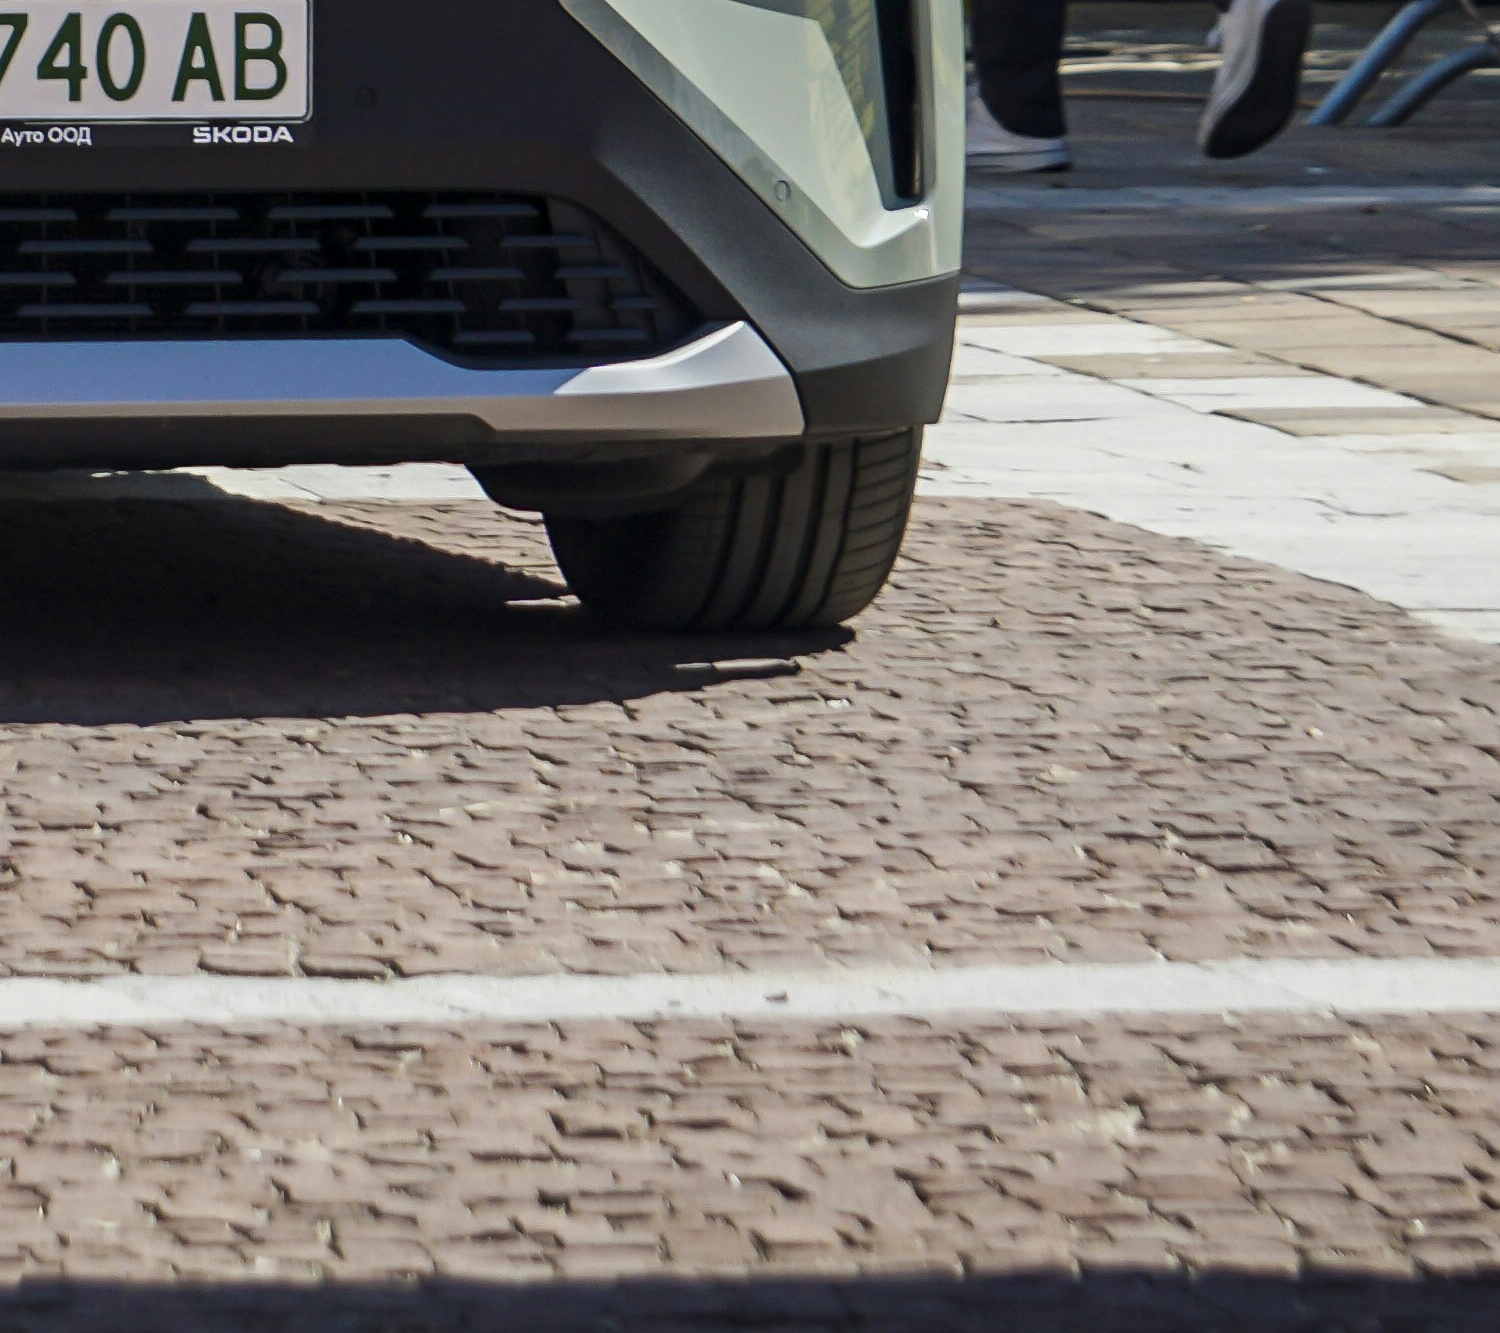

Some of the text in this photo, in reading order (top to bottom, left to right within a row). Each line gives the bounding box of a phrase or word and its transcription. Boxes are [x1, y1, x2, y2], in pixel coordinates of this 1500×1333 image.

[170, 11, 288, 103] AB
[1, 128, 47, 148] Ауто
[47, 127, 93, 148] ООД
